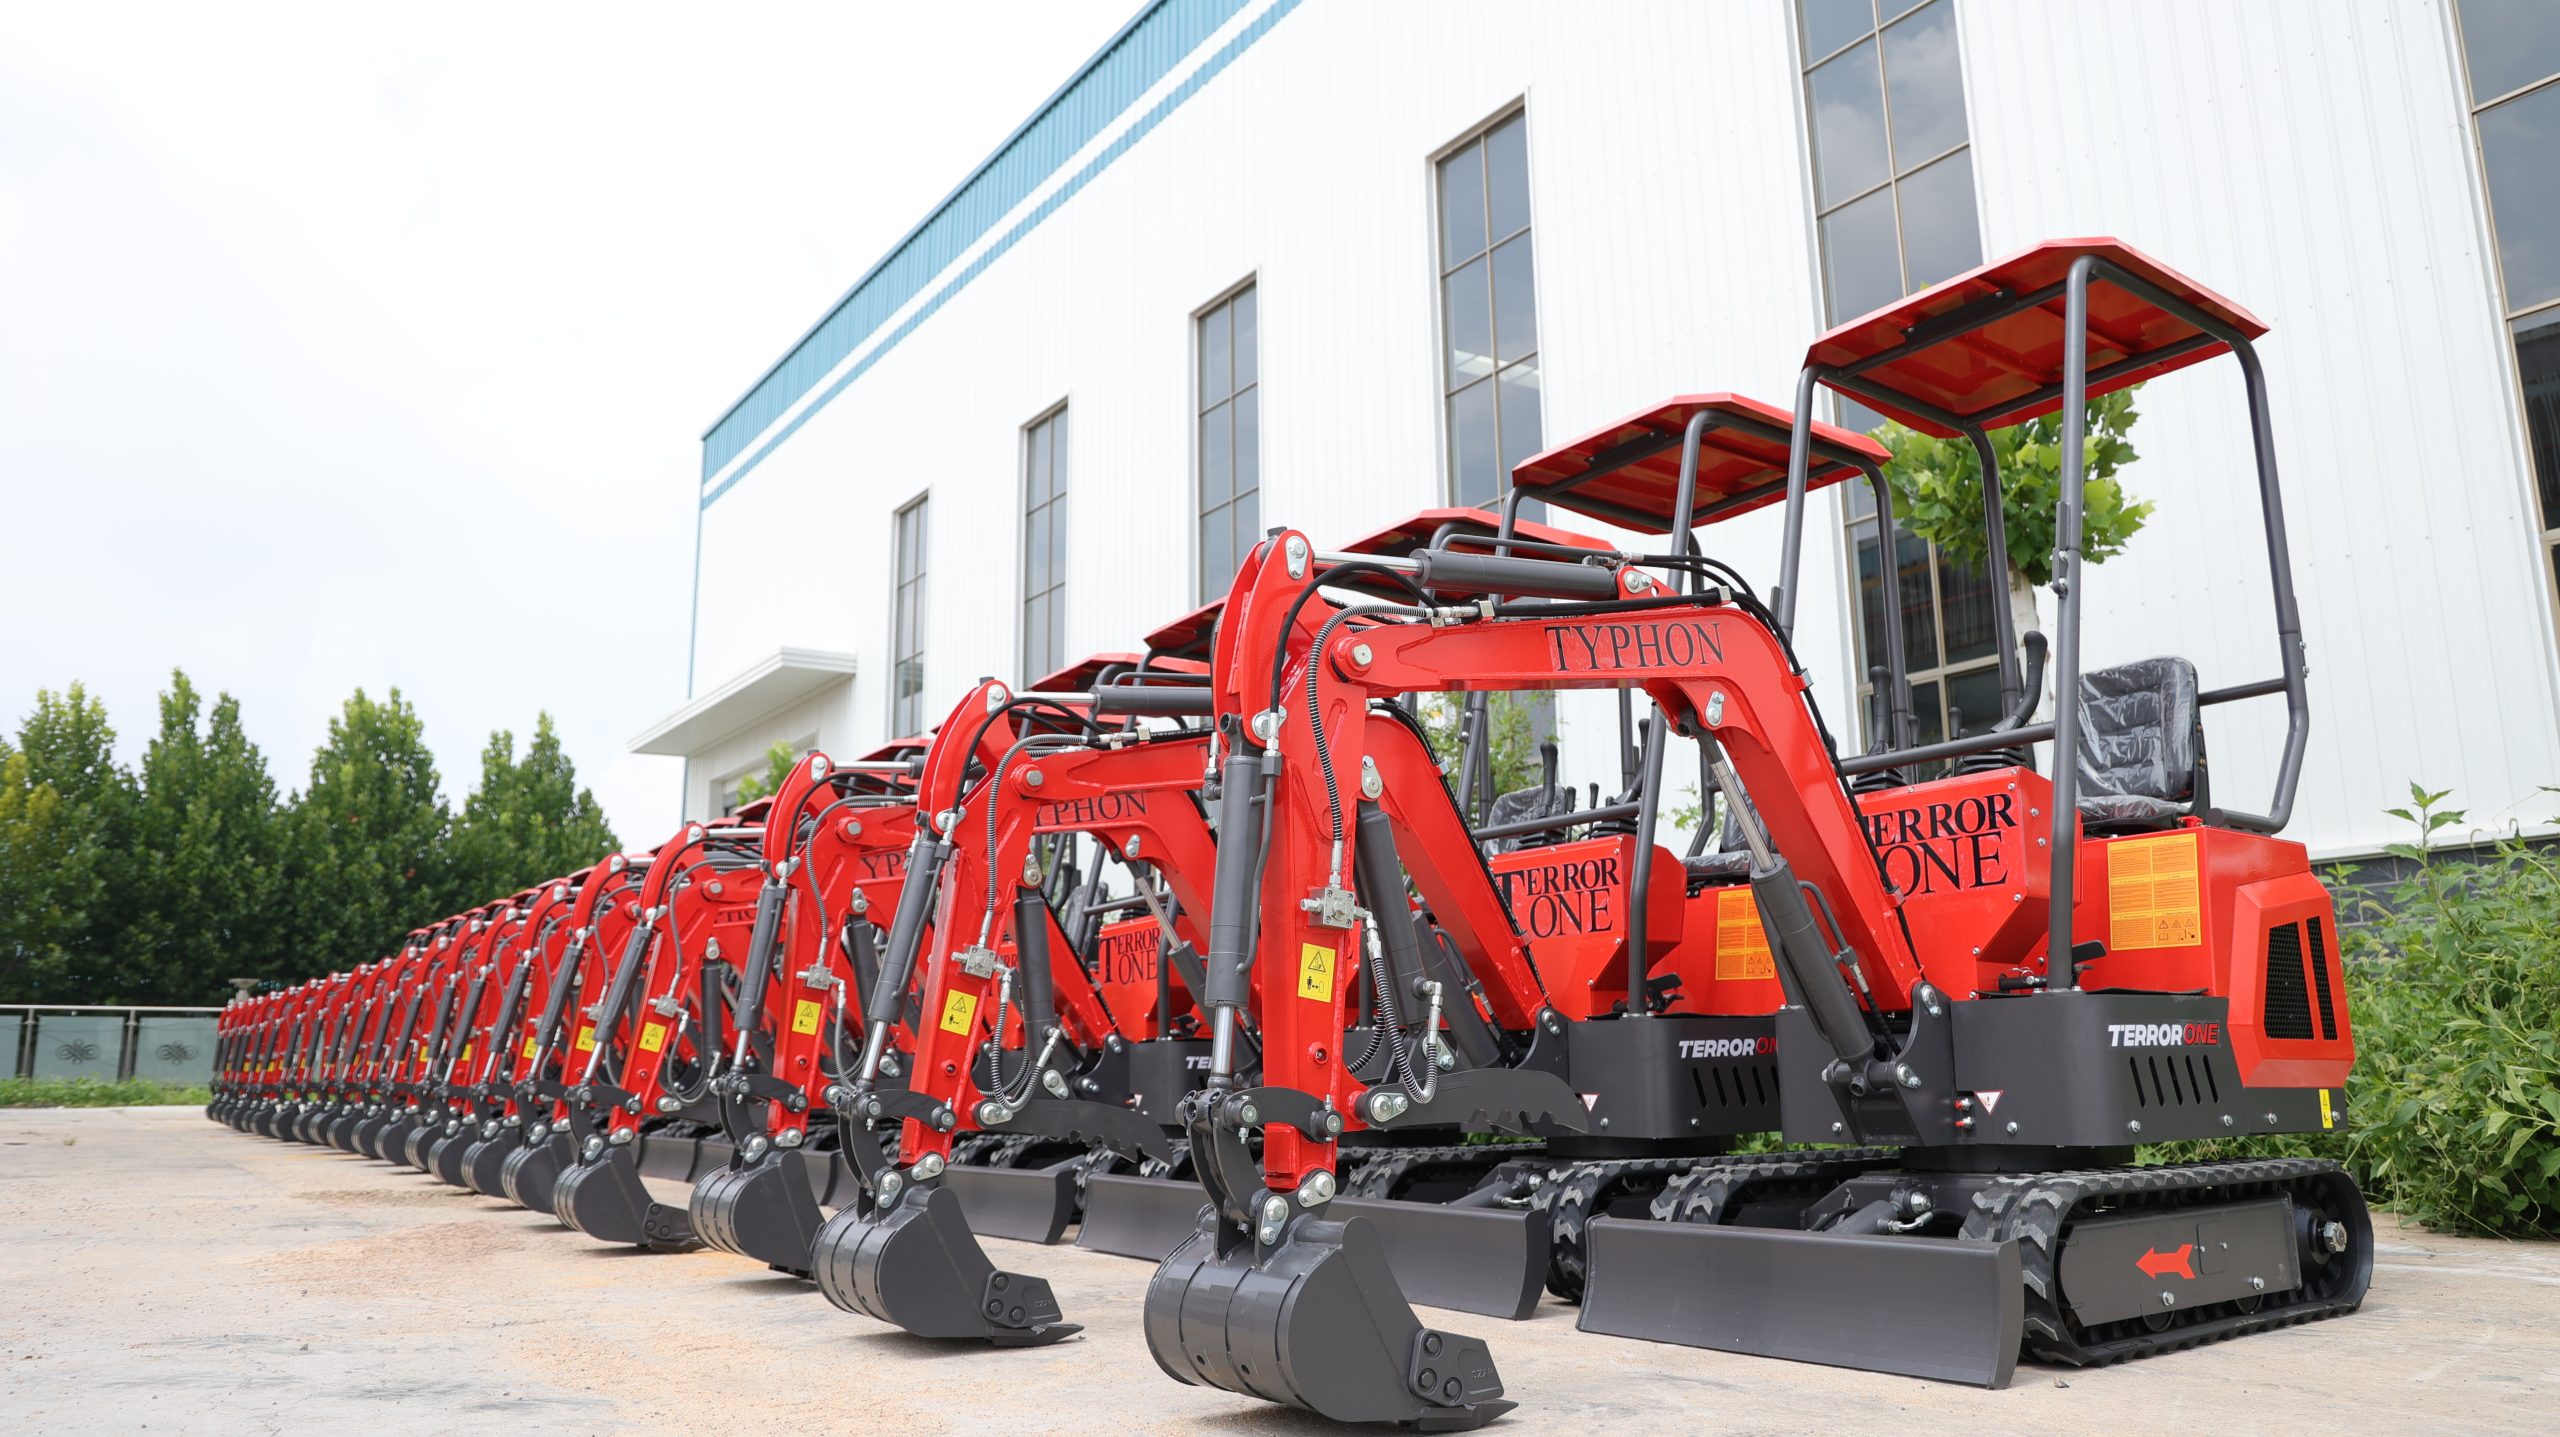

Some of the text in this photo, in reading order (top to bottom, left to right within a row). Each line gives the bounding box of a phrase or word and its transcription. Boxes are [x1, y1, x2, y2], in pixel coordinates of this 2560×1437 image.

[1545, 623, 1724, 671] TYPHON
[1035, 793, 1146, 827] PHON
[1880, 831, 2008, 898] ONE
[1530, 888, 1613, 938] ONE
[1100, 927, 1160, 983] TERROR
[1118, 949, 1158, 985] ONE
